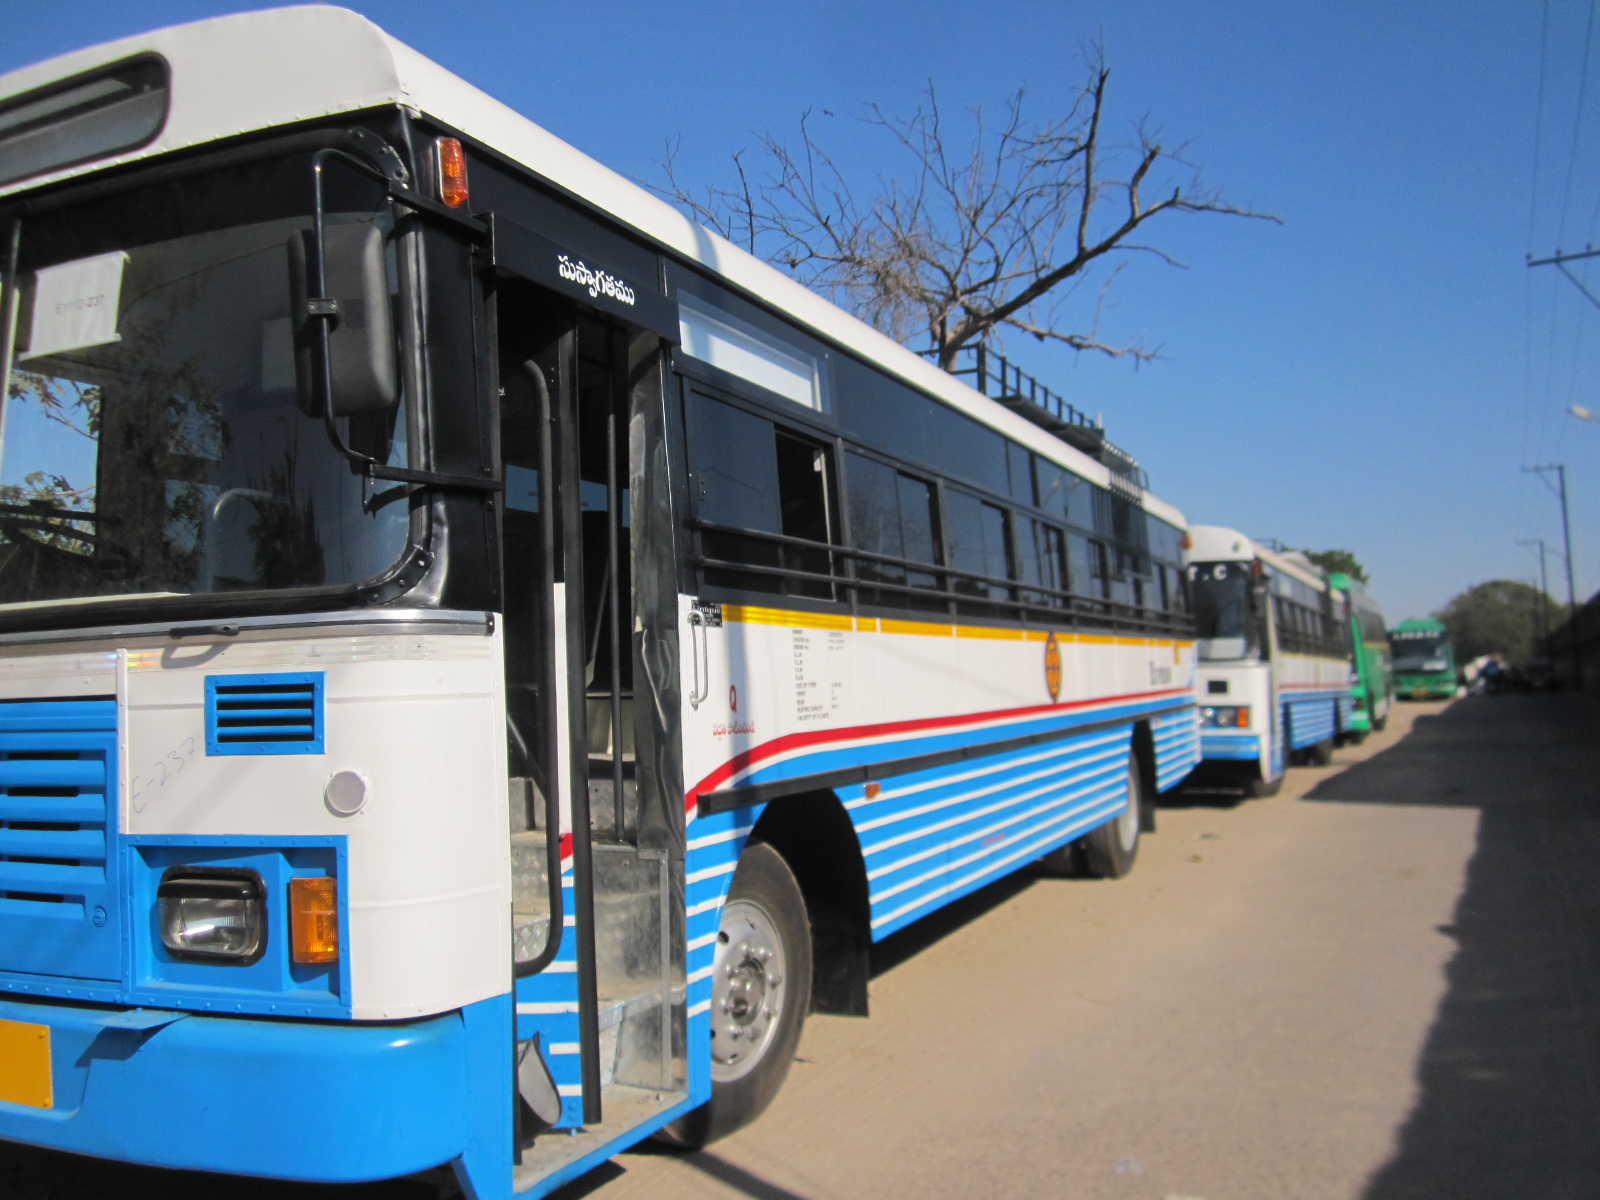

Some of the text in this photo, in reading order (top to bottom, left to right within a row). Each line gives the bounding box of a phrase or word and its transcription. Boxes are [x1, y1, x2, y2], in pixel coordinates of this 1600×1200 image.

[558, 254, 634, 306] సుస్వాగతము
[729, 684, 738, 713] Q
[132, 736, 194, 813] E-237
